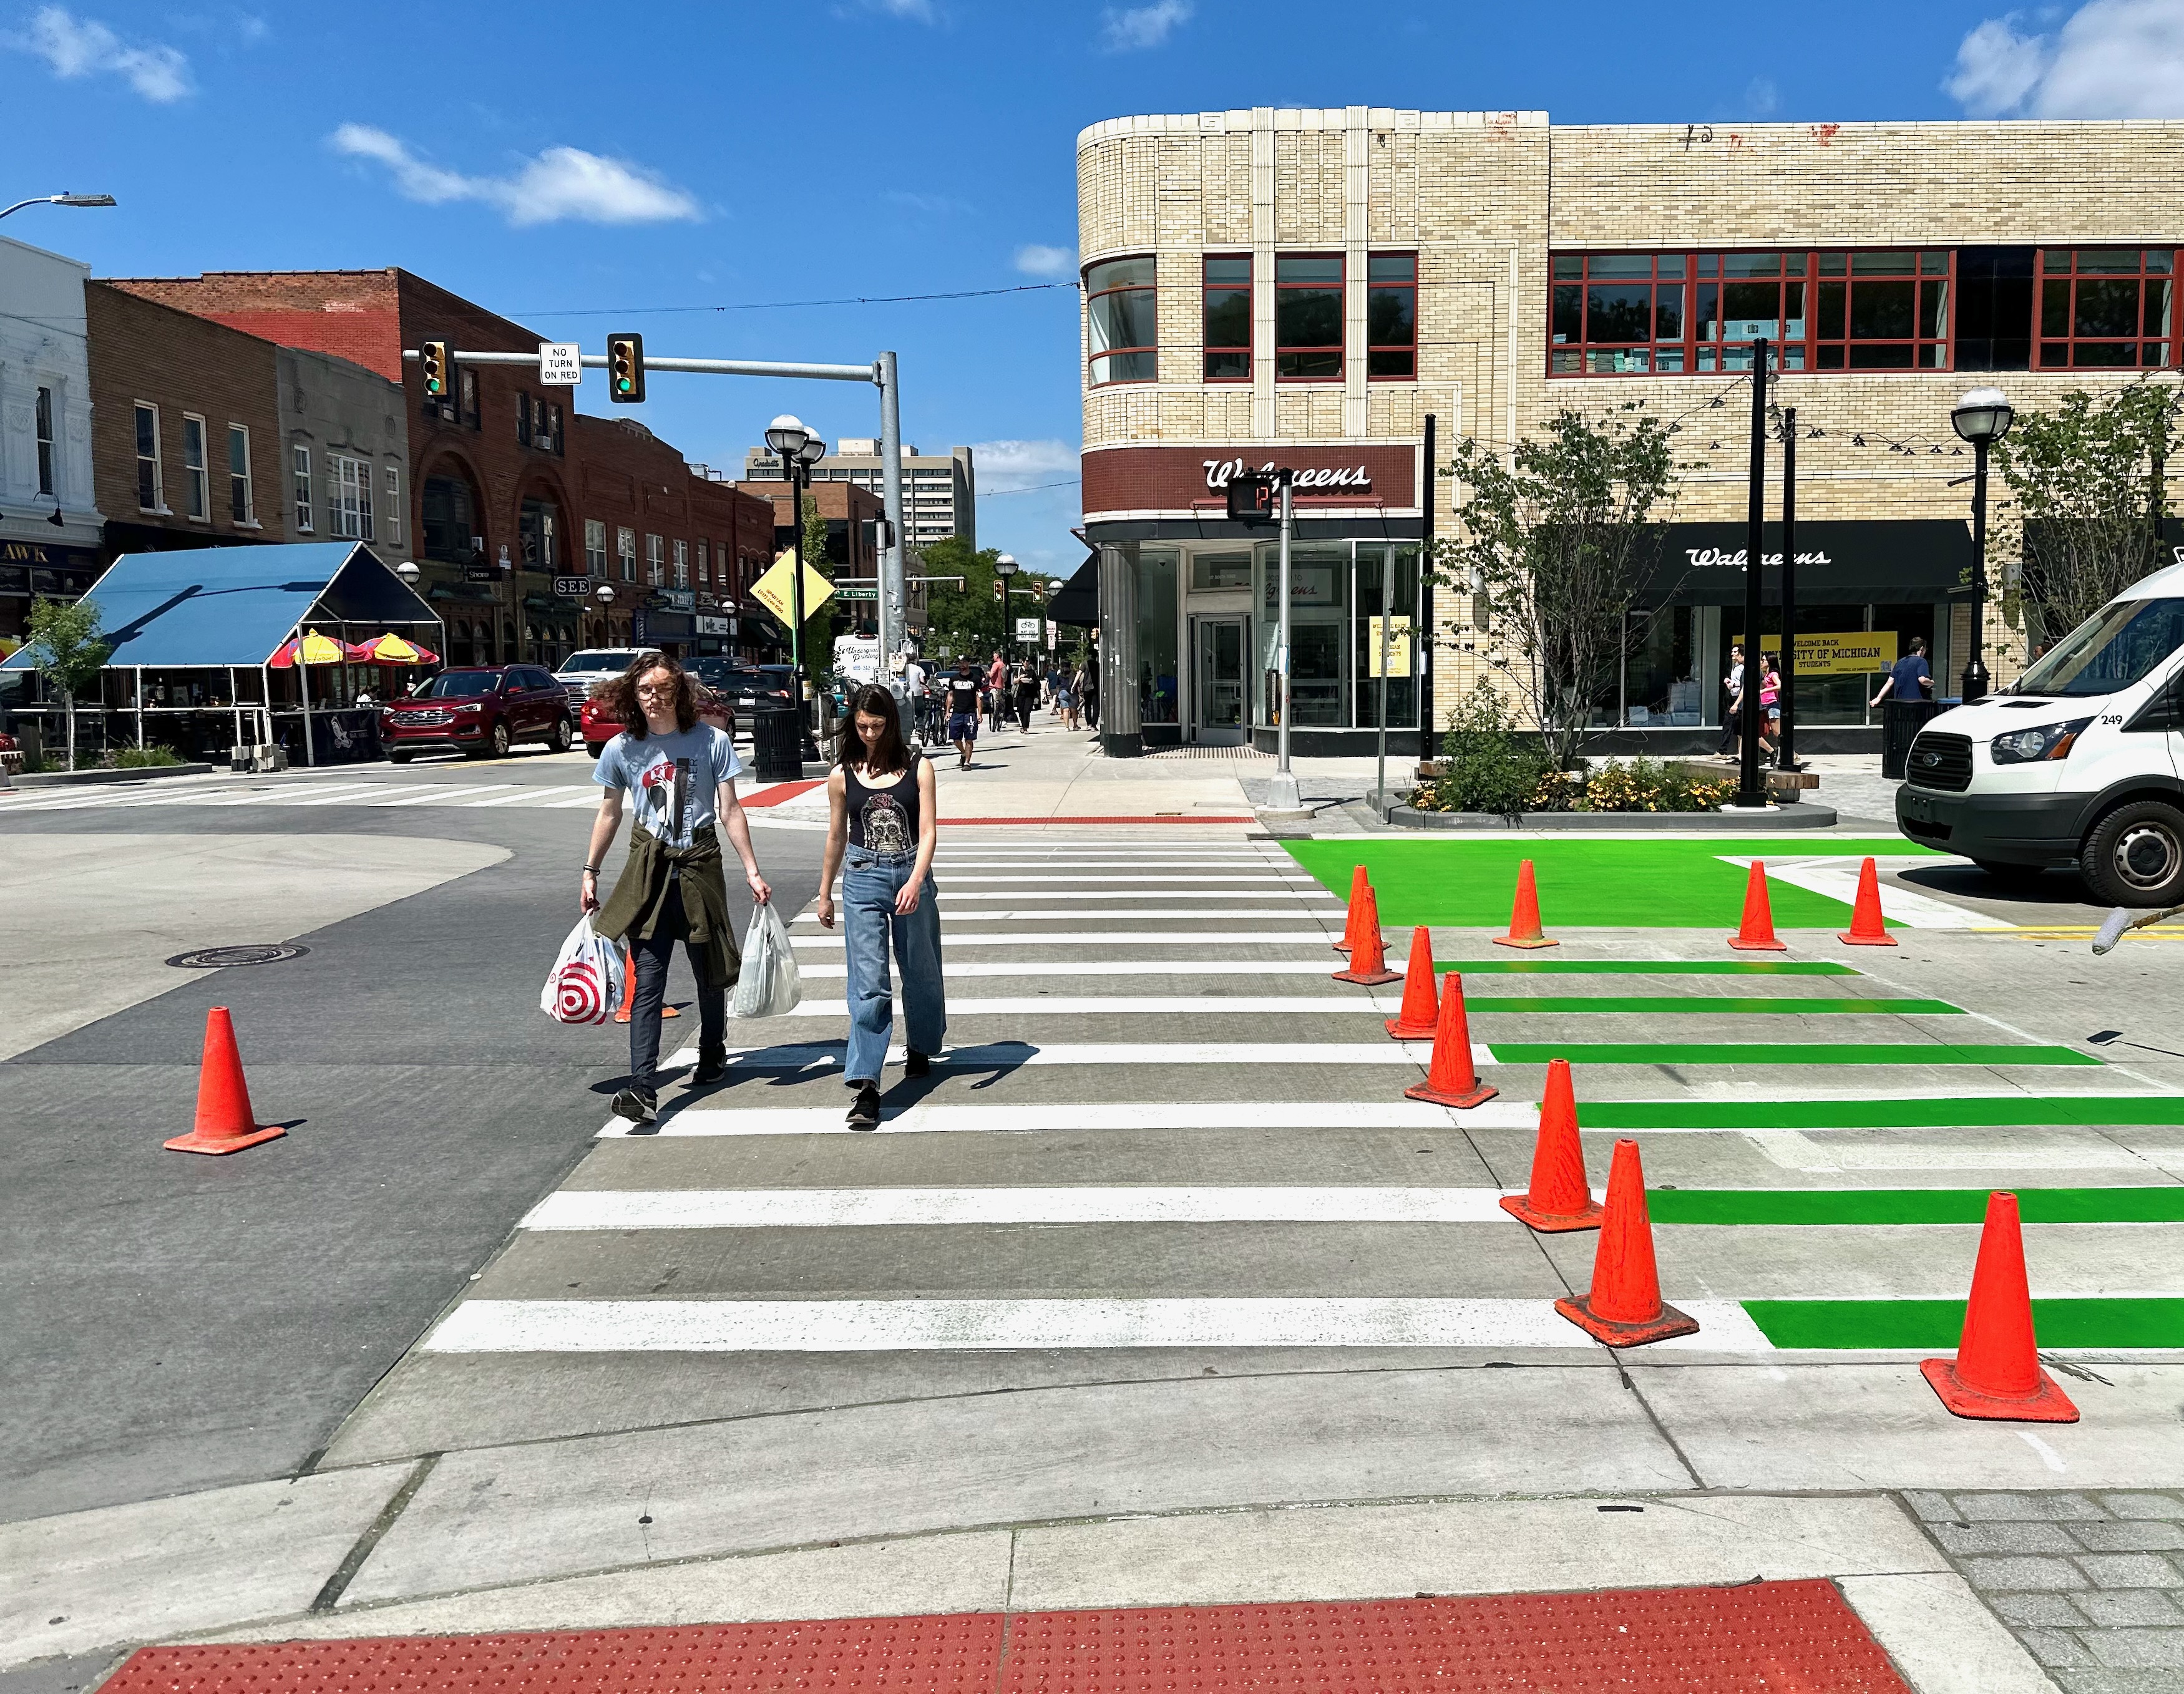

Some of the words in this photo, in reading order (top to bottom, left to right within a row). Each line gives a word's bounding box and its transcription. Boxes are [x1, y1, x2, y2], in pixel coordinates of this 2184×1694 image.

[549, 359, 572, 368] TURN
[545, 371, 557, 379] ON
[561, 371, 577, 379] RED
[1203, 457, 1372, 494] Wlreens
[1256, 487, 1269, 510] 12
[1685, 547, 1831, 572] Walrens
[558, 581, 587, 593] SEE
[1817, 650, 1830, 659] OF
[1832, 647, 1881, 659] MICHIGAN
[2101, 715, 2123, 725] 249
[683, 759, 698, 837] HEADBANGER
